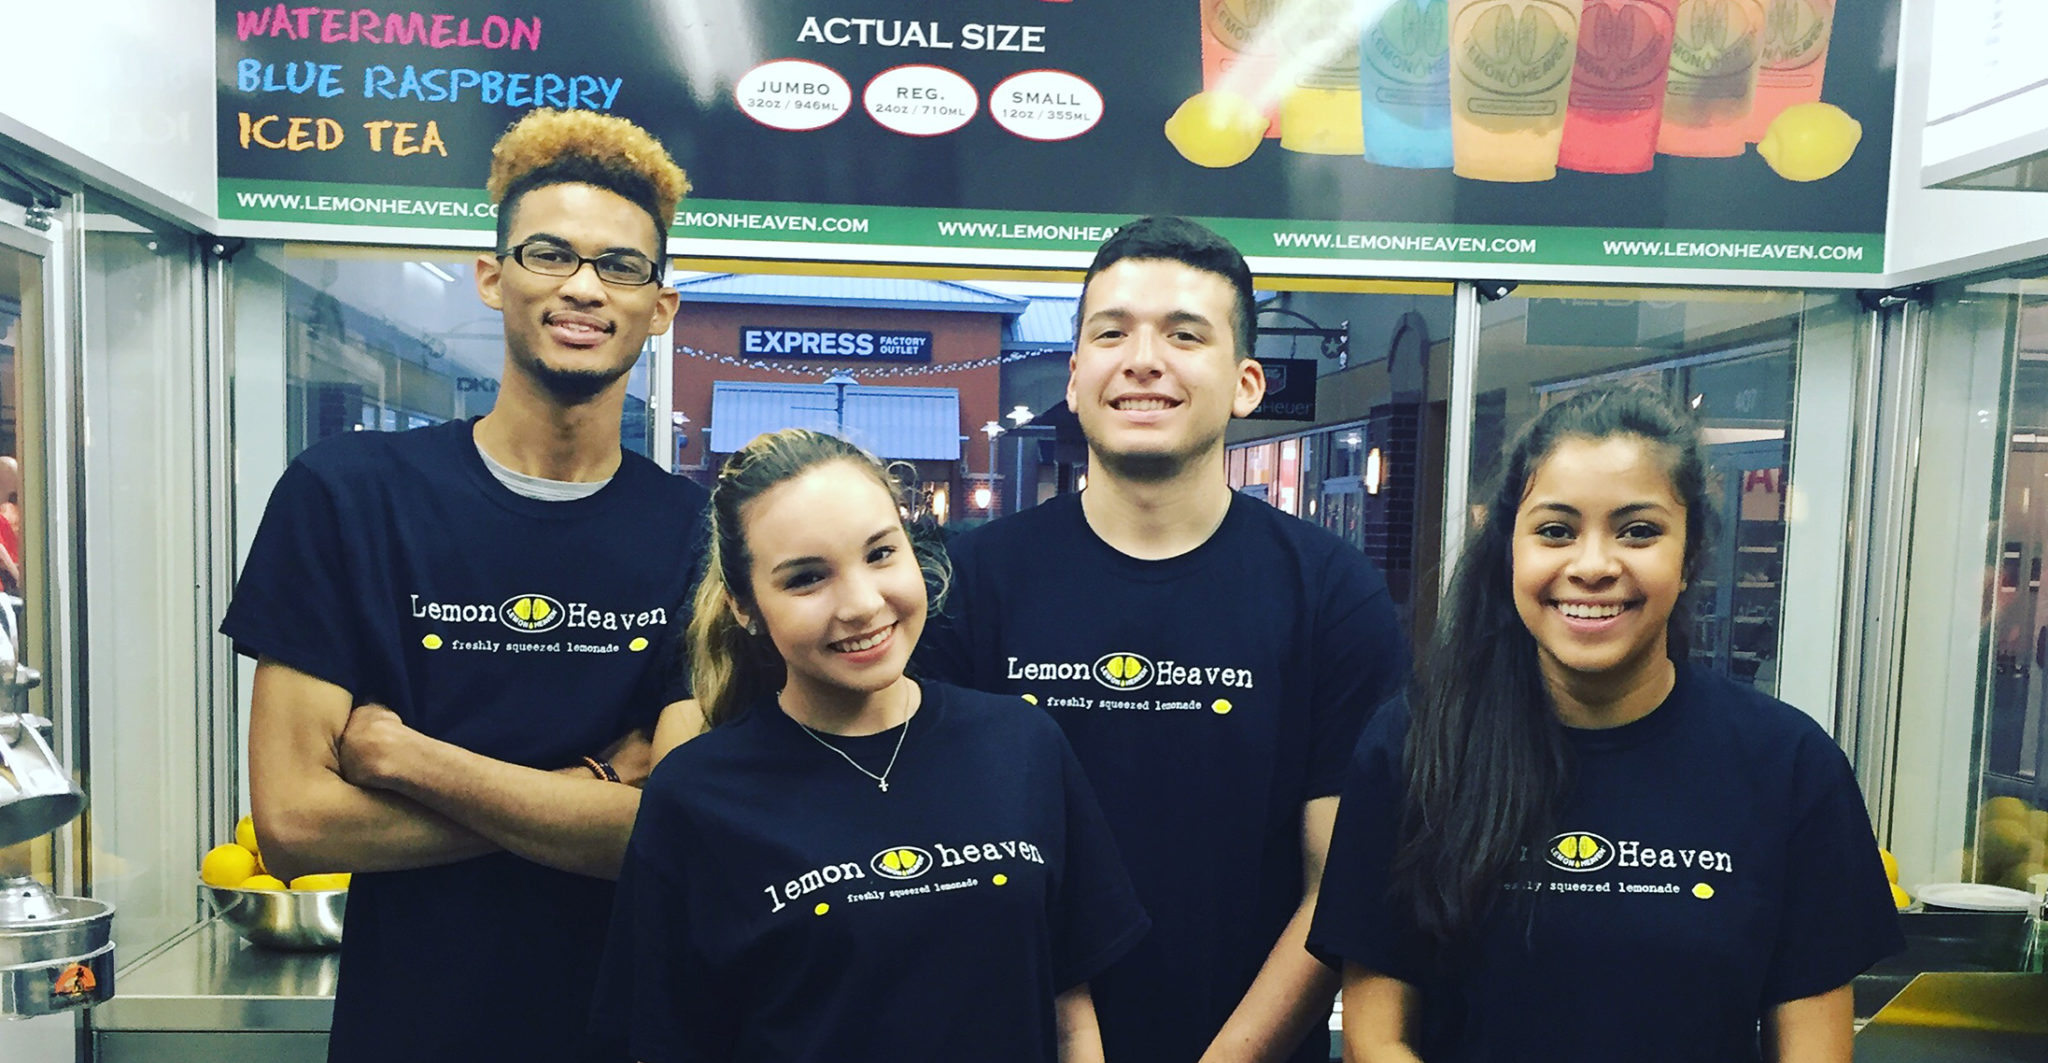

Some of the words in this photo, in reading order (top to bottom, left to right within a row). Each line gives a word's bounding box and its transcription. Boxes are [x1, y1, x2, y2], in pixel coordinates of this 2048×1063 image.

[237, 3, 542, 51] WATERMELON
[797, 16, 953, 49] ACTUAL
[961, 23, 1046, 53] SIZE
[238, 58, 345, 98] BLUE
[364, 64, 622, 109] RASPBERRY
[757, 81, 831, 96] JUMBO
[897, 87, 945, 100] REG.
[1012, 92, 1081, 106] SMALL
[238, 112, 345, 152] ICED
[363, 120, 448, 157] TEA
[237, 192, 499, 218] WWW.LEMONHEAVEN.CO
[672, 211, 869, 233] EMONHEAVEN.COM
[938, 221, 1119, 241] WWW.LEMONHEA
[1273, 232, 1537, 254] WWW.LEMONHEAVEN.COM
[1603, 240, 1864, 261] WWW.LEMONHEAVEN.COM
[745, 330, 874, 356] EXPRESS
[879, 336, 926, 346] FACTORY
[880, 346, 919, 355] OUTLET
[410, 594, 497, 622] Lemon
[567, 602, 667, 630] Heaven
[452, 640, 500, 652] freshly
[506, 643, 560, 653] squeezed
[567, 642, 619, 653] lemonade
[1007, 657, 1091, 680] Lemon
[1156, 661, 1253, 688] Heaven
[1047, 697, 1093, 709] freshly
[1099, 699, 1149, 711] squeezed
[1155, 700, 1202, 711] lemonade
[1618, 841, 1733, 873] Heaven
[764, 861, 865, 914] lemon
[934, 840, 1045, 868] heaven
[1550, 882, 1611, 893] squeezed
[1618, 881, 1681, 893] lemonade
[847, 891, 885, 903] freshly
[889, 885, 931, 898] squeezed
[934, 878, 978, 892] lemonade
